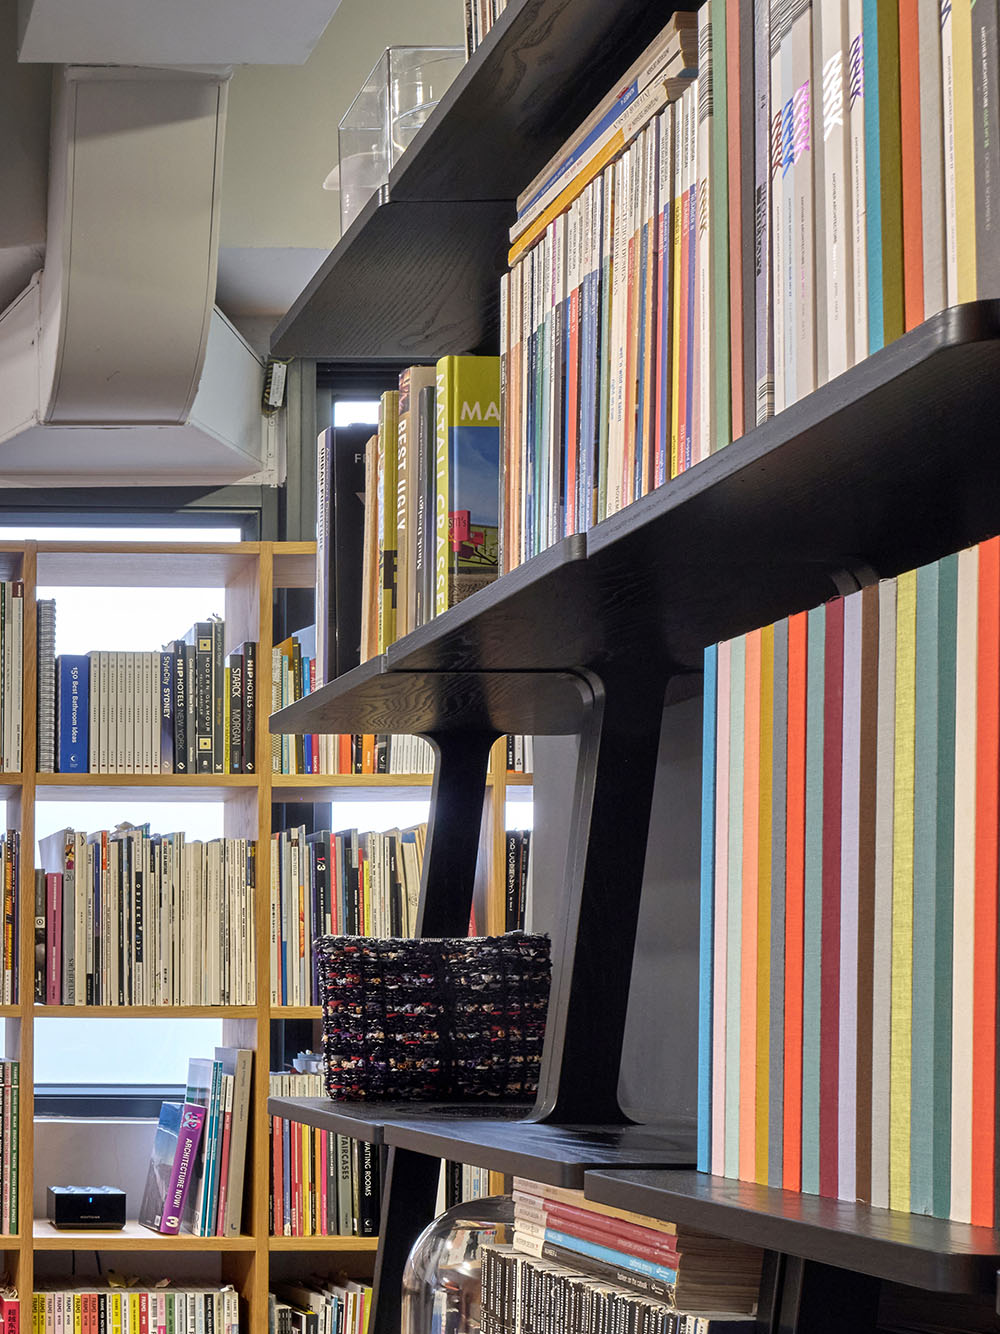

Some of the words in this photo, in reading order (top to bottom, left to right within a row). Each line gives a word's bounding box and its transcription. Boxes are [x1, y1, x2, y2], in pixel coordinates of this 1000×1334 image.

[436, 373, 446, 481] MATALI
[398, 420, 407, 471] BEST
[397, 481, 406, 531] UGLY
[416, 495, 424, 537] Design
[70, 666, 79, 679] 150
[163, 655, 171, 686] StyleCity
[176, 658, 184, 678] HIP
[232, 667, 241, 698] STARCK
[246, 659, 254, 678] HIP
[70, 680, 79, 695] Best
[177, 678, 185, 707] HOTELS
[246, 678, 254, 708] HOTELS
[70, 695, 79, 726] Bathroom
[163, 687, 171, 719] SYDNEY
[177, 709, 185, 727] NEW
[231, 708, 241, 746] MORGAN
[70, 726, 78, 743] Ideas
[177, 729, 186, 751] YORK
[177, 1137, 193, 1190] ARCHITECTURE
[172, 1191, 185, 1209] NOW!
[364, 1174, 372, 1197] ROOMS
[165, 1215, 180, 1228] 3
